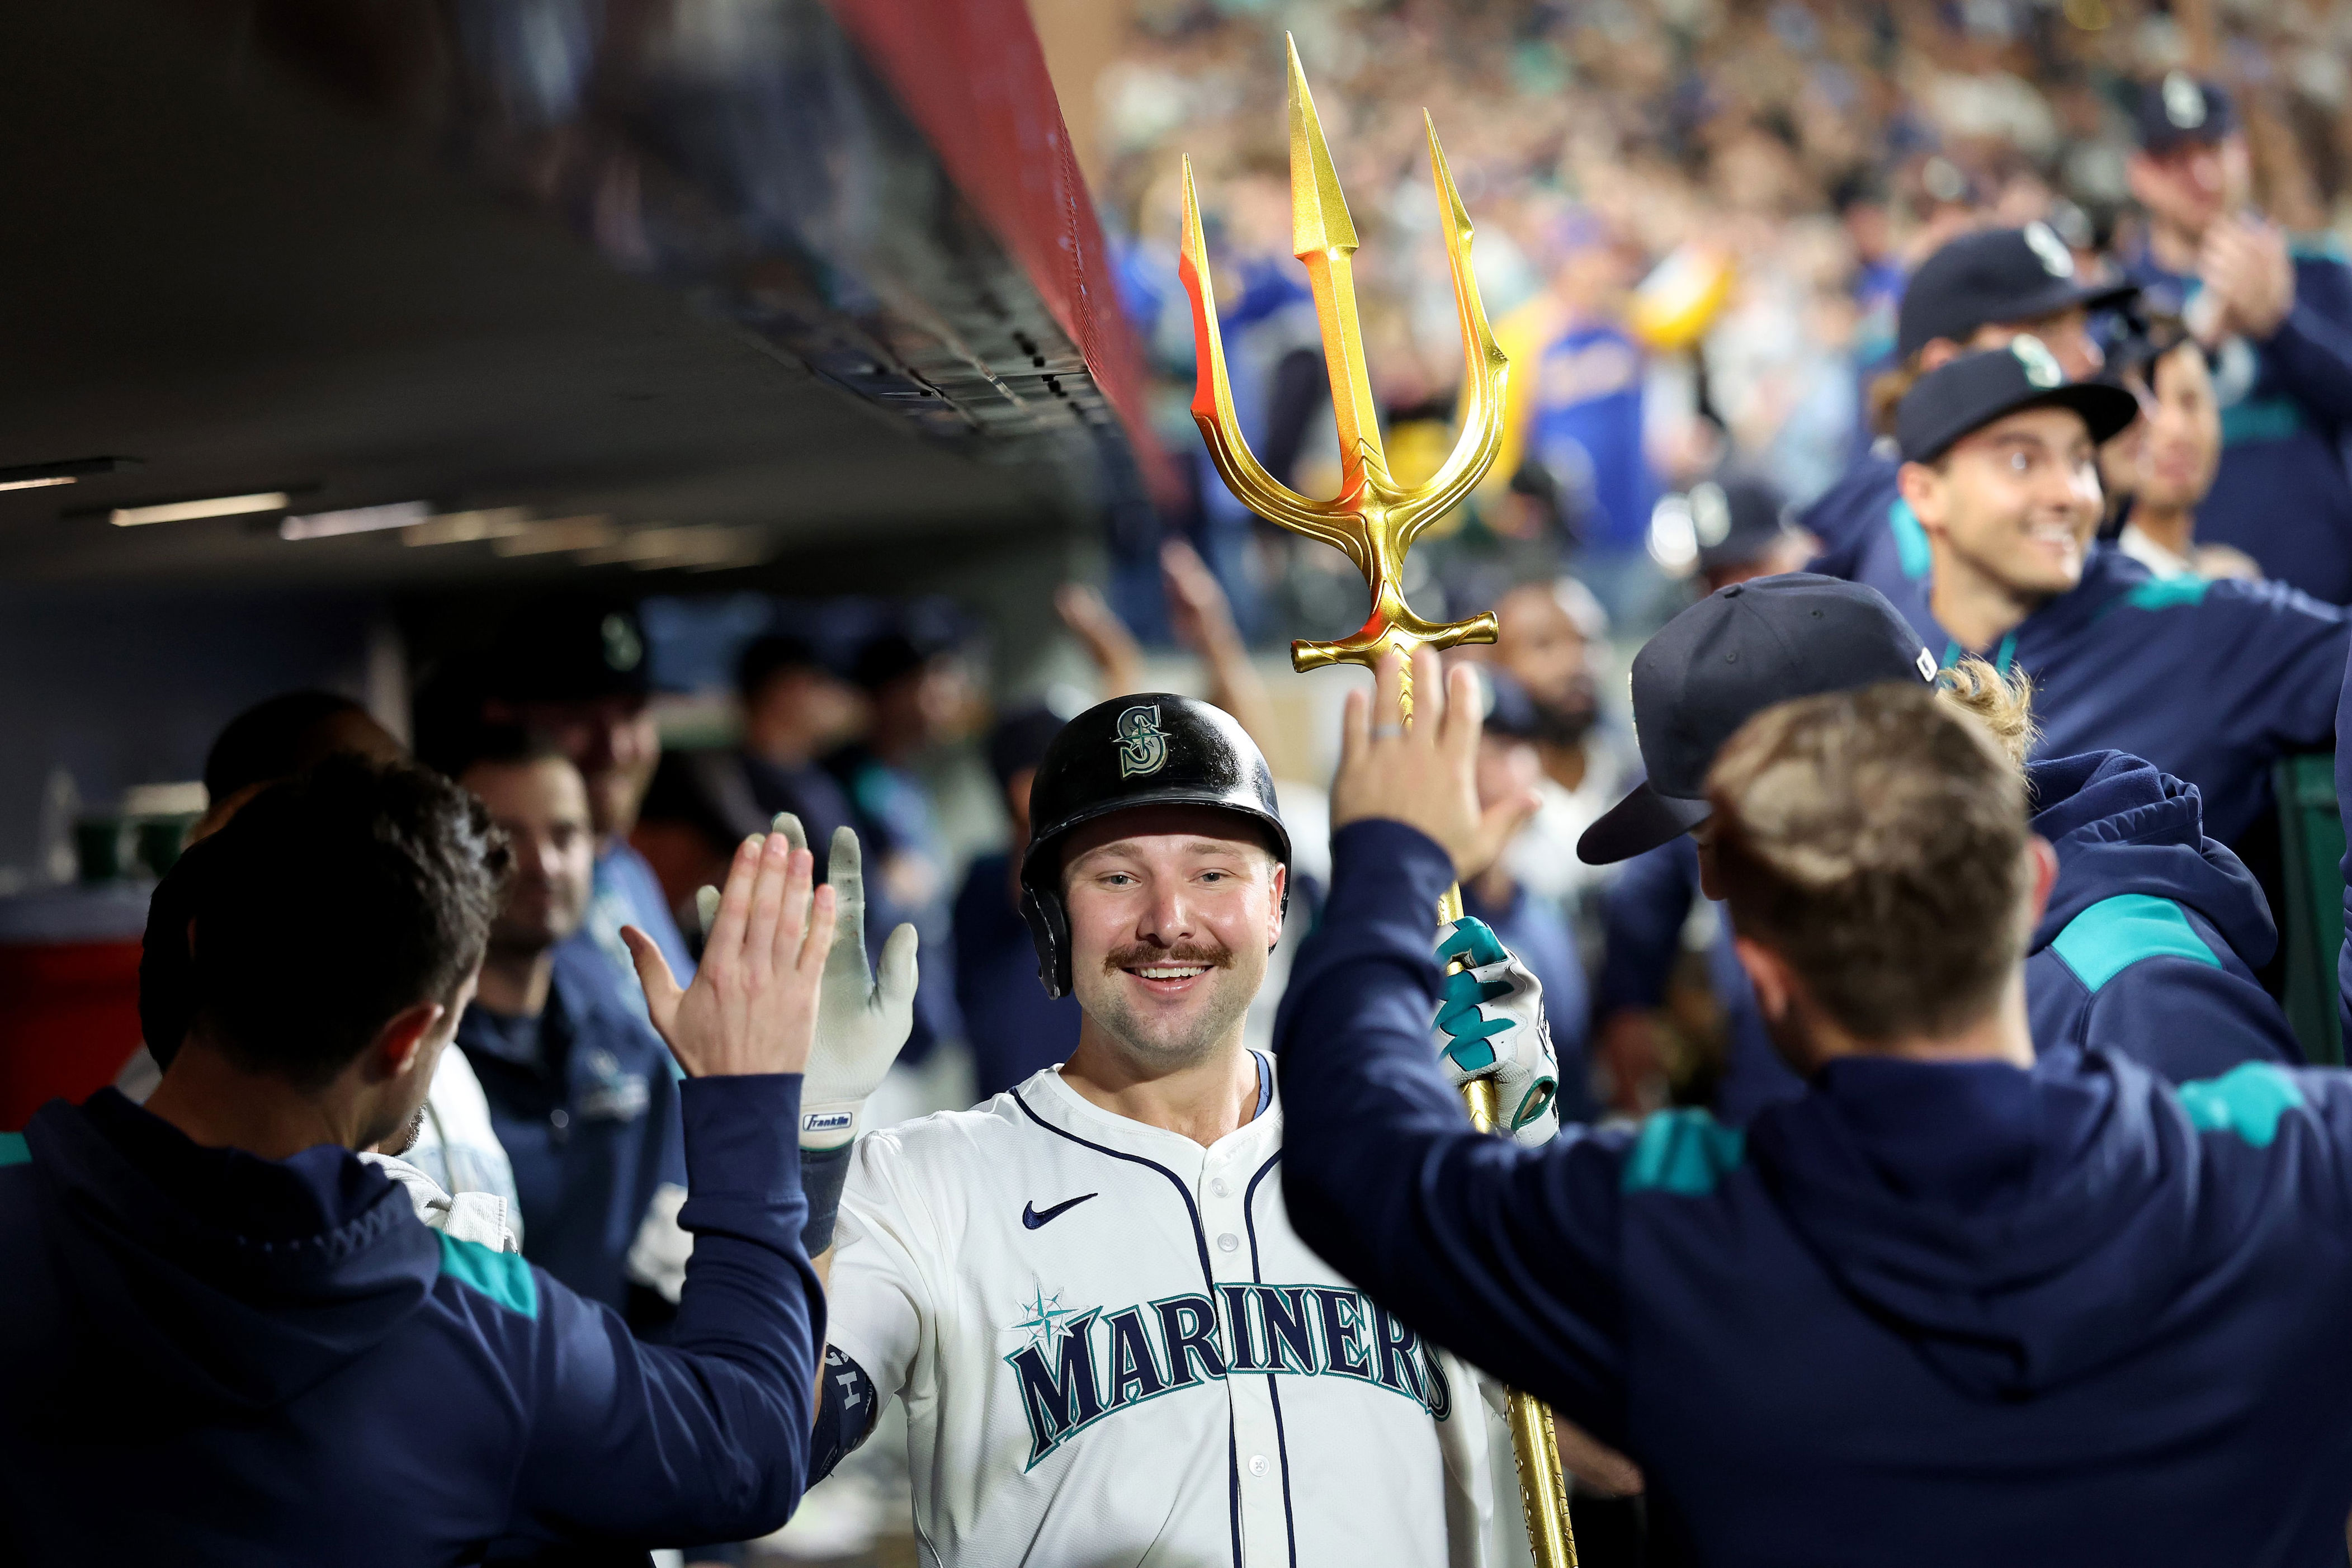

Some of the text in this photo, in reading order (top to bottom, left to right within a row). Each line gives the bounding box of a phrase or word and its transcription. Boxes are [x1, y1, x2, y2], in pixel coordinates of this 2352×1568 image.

[1117, 705, 1168, 778] S
[806, 1114, 849, 1130] Franklin
[1003, 1283, 1452, 1473] MARINERS
